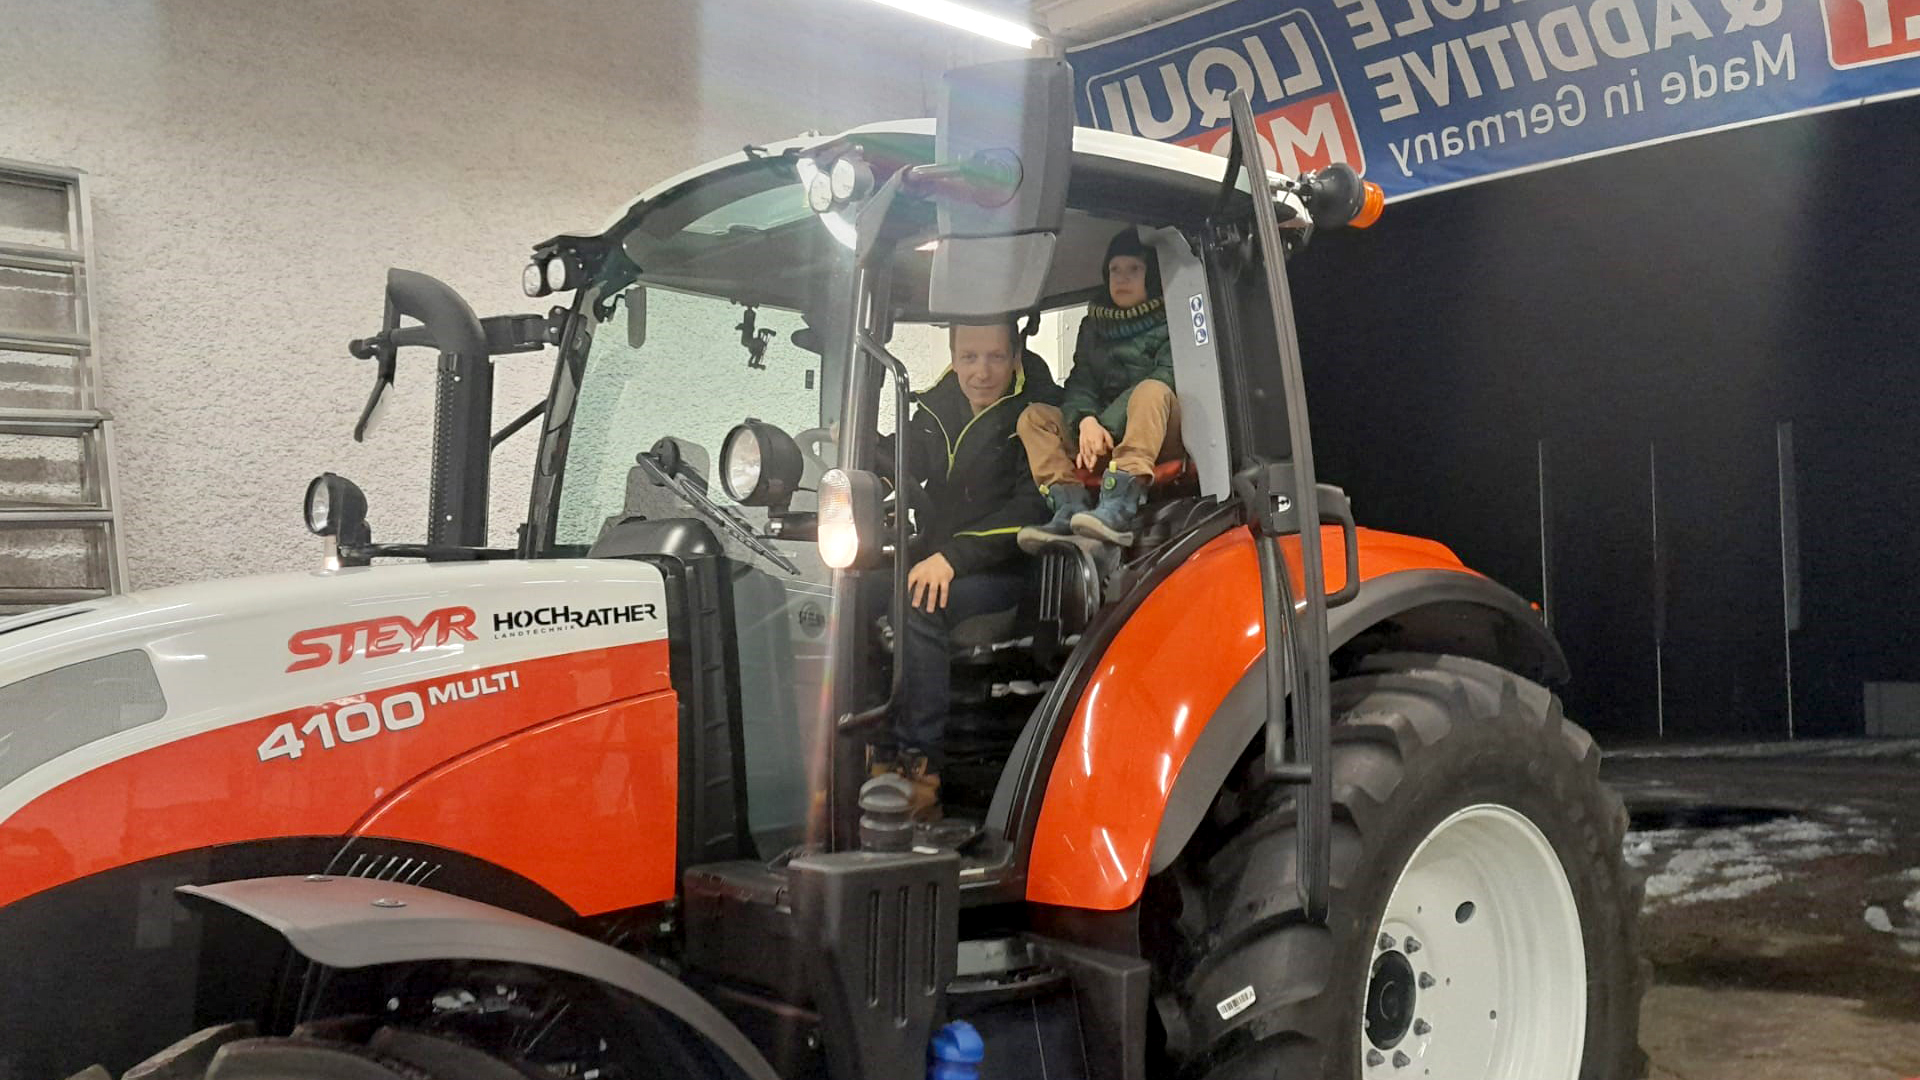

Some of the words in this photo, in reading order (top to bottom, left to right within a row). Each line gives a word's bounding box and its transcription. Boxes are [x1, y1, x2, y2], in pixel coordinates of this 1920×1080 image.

[285, 605, 479, 674] STEYR
[493, 604, 658, 632] HOCHRATHER
[494, 625, 576, 640] LANDTECHNIK
[257, 691, 425, 762] 4100
[428, 670, 520, 706] MULTI
